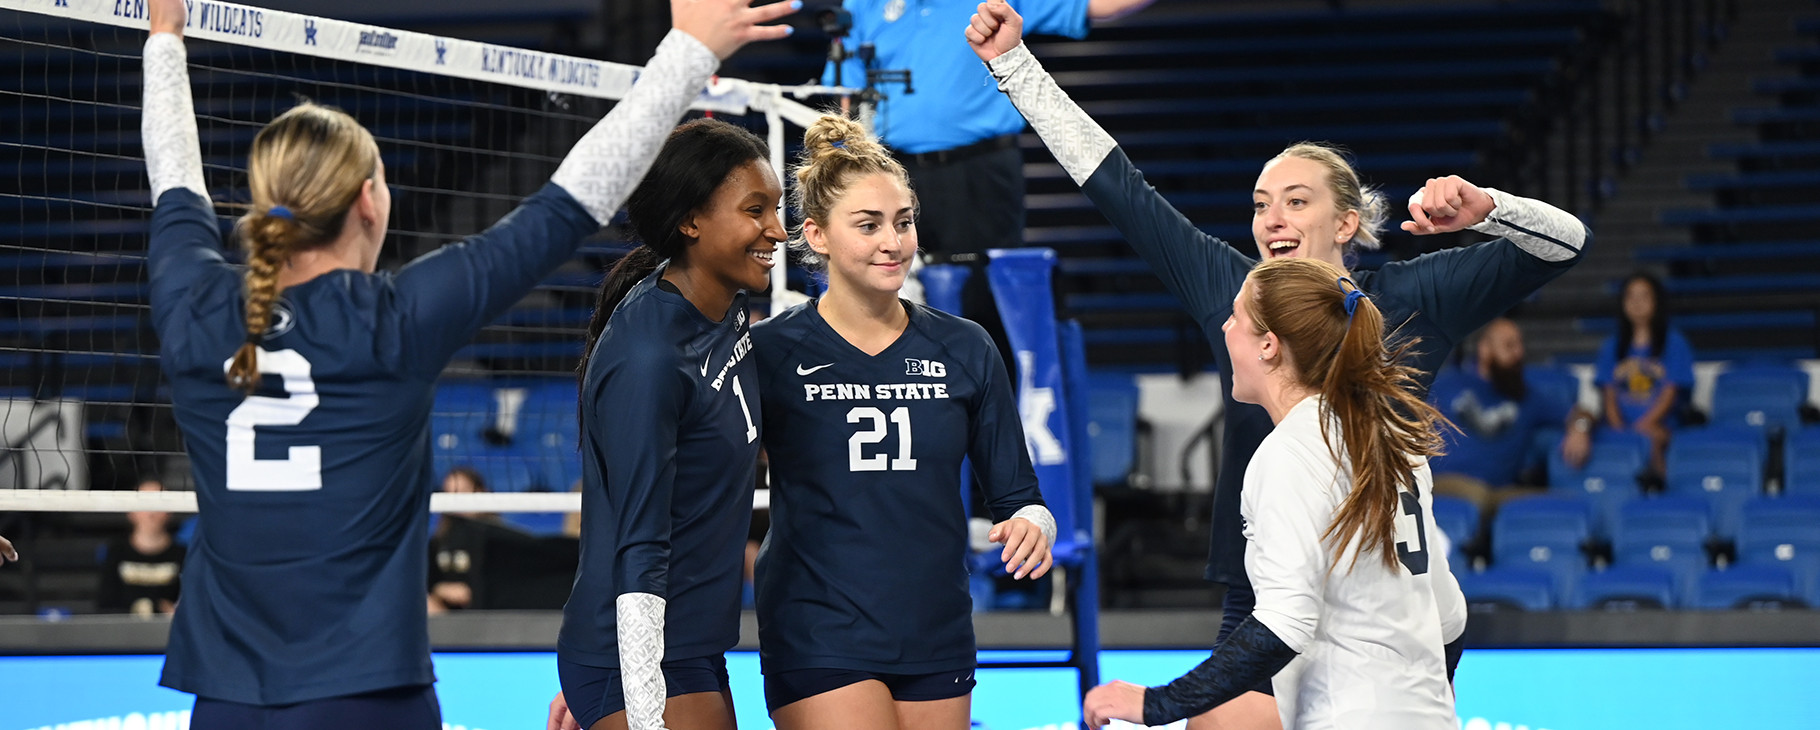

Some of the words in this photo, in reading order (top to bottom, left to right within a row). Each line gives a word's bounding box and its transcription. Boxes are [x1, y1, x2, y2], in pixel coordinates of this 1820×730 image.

[113, 0, 194, 27] KENY
[199, 2, 263, 38] WILDCATS
[804, 384, 871, 402] PENN
[875, 383, 950, 400] STATE
[905, 358, 947, 377] BIG
[223, 347, 323, 491] 2
[732, 375, 758, 444] 1
[846, 406, 918, 472] 21
